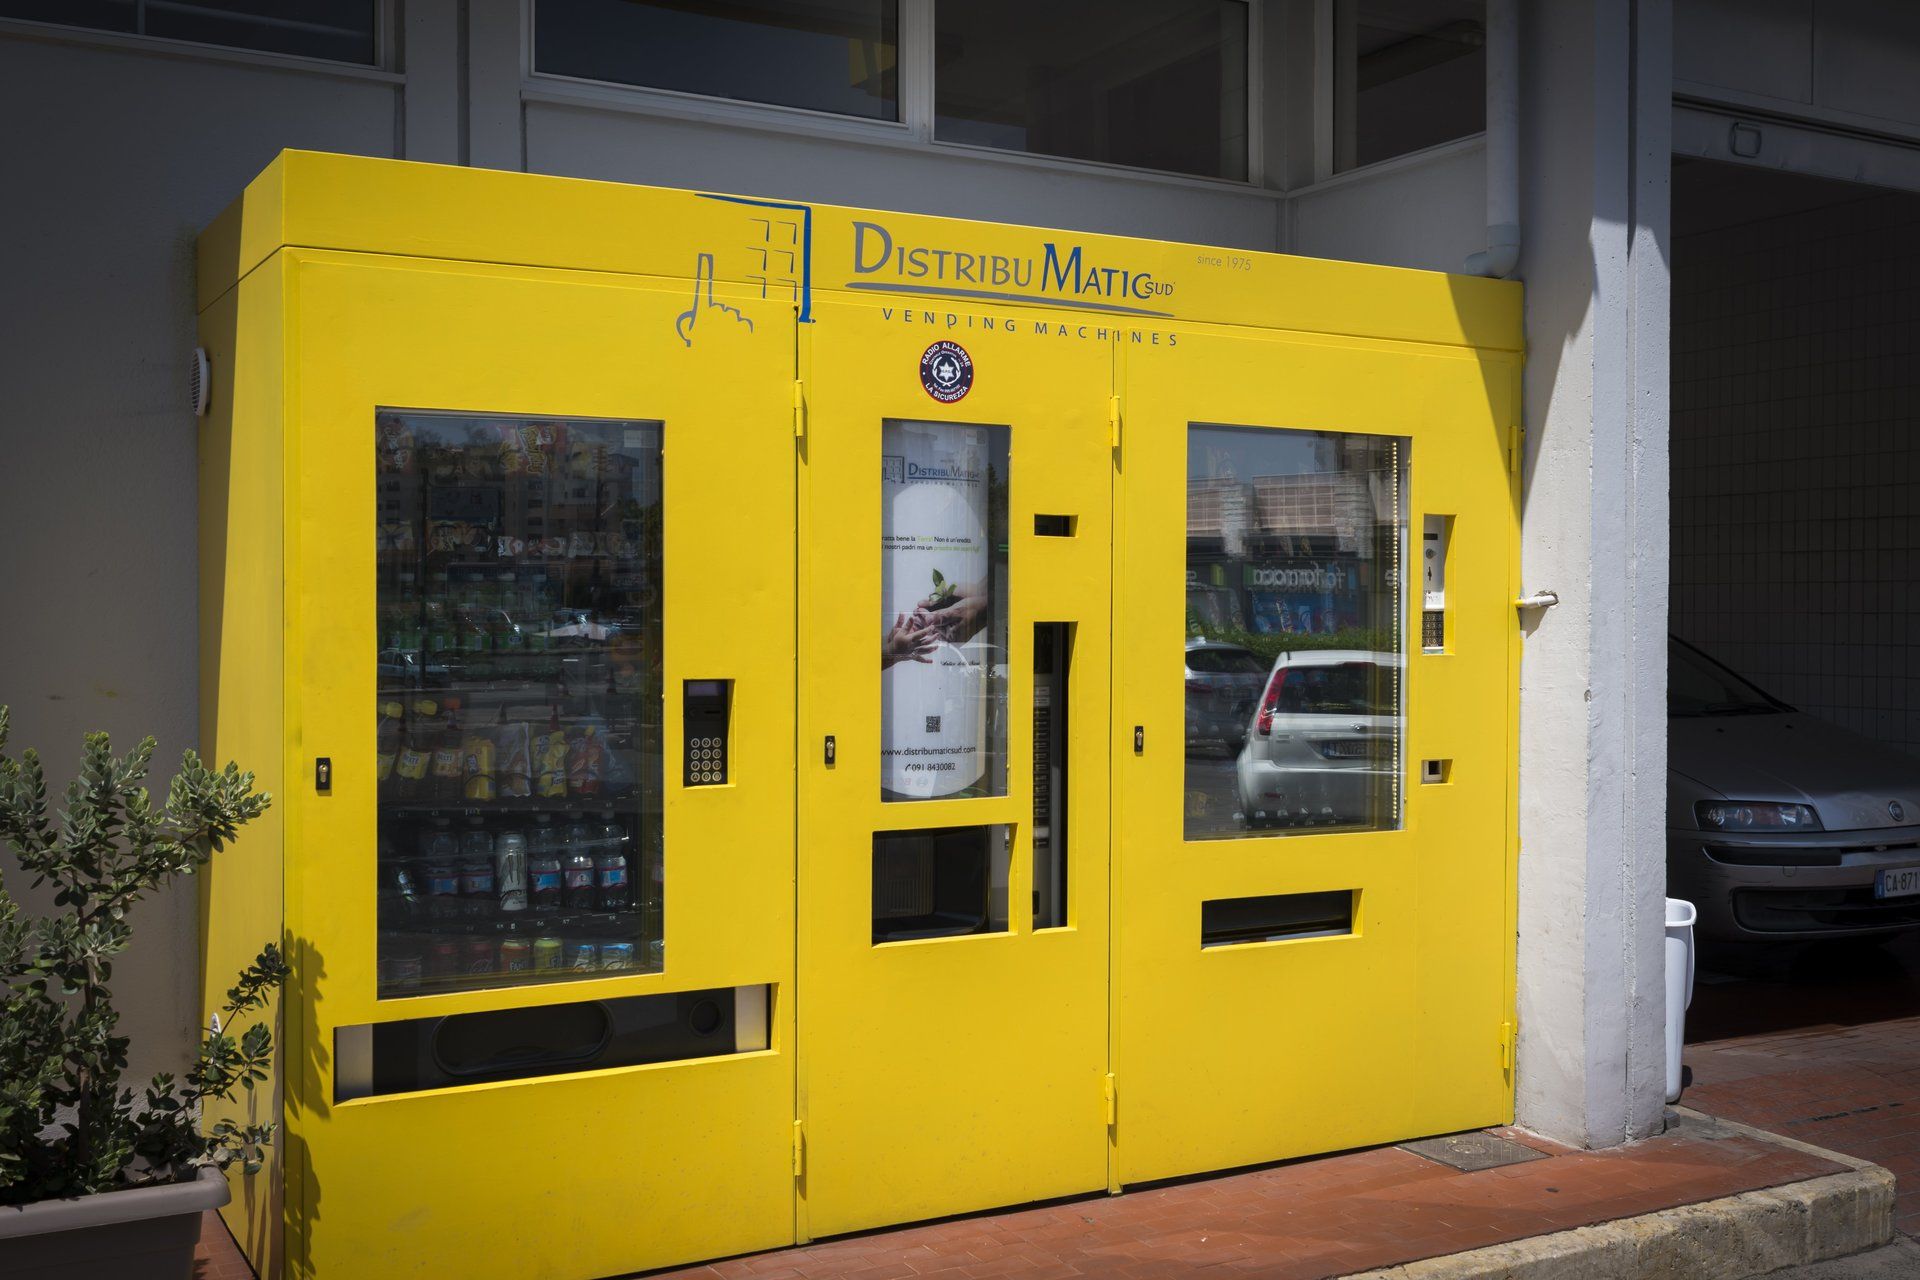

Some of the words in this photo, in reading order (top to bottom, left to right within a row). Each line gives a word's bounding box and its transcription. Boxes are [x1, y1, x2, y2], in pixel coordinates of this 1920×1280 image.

[1197, 255, 1222, 267] since
[1227, 255, 1251, 271] 1975
[883, 307, 1015, 332] VENDING
[1035, 321, 1177, 346] MACHINES
[922, 344, 940, 365] RADIO
[942, 342, 972, 367] ALLARME
[925, 383, 933, 393] LA
[933, 386, 968, 401] SICUREZZA
[901, 544, 916, 552] padri
[881, 746, 976, 756] www.distribumaticsud.com
[912, 763, 925, 771] 091
[927, 762, 956, 771] 8430082
